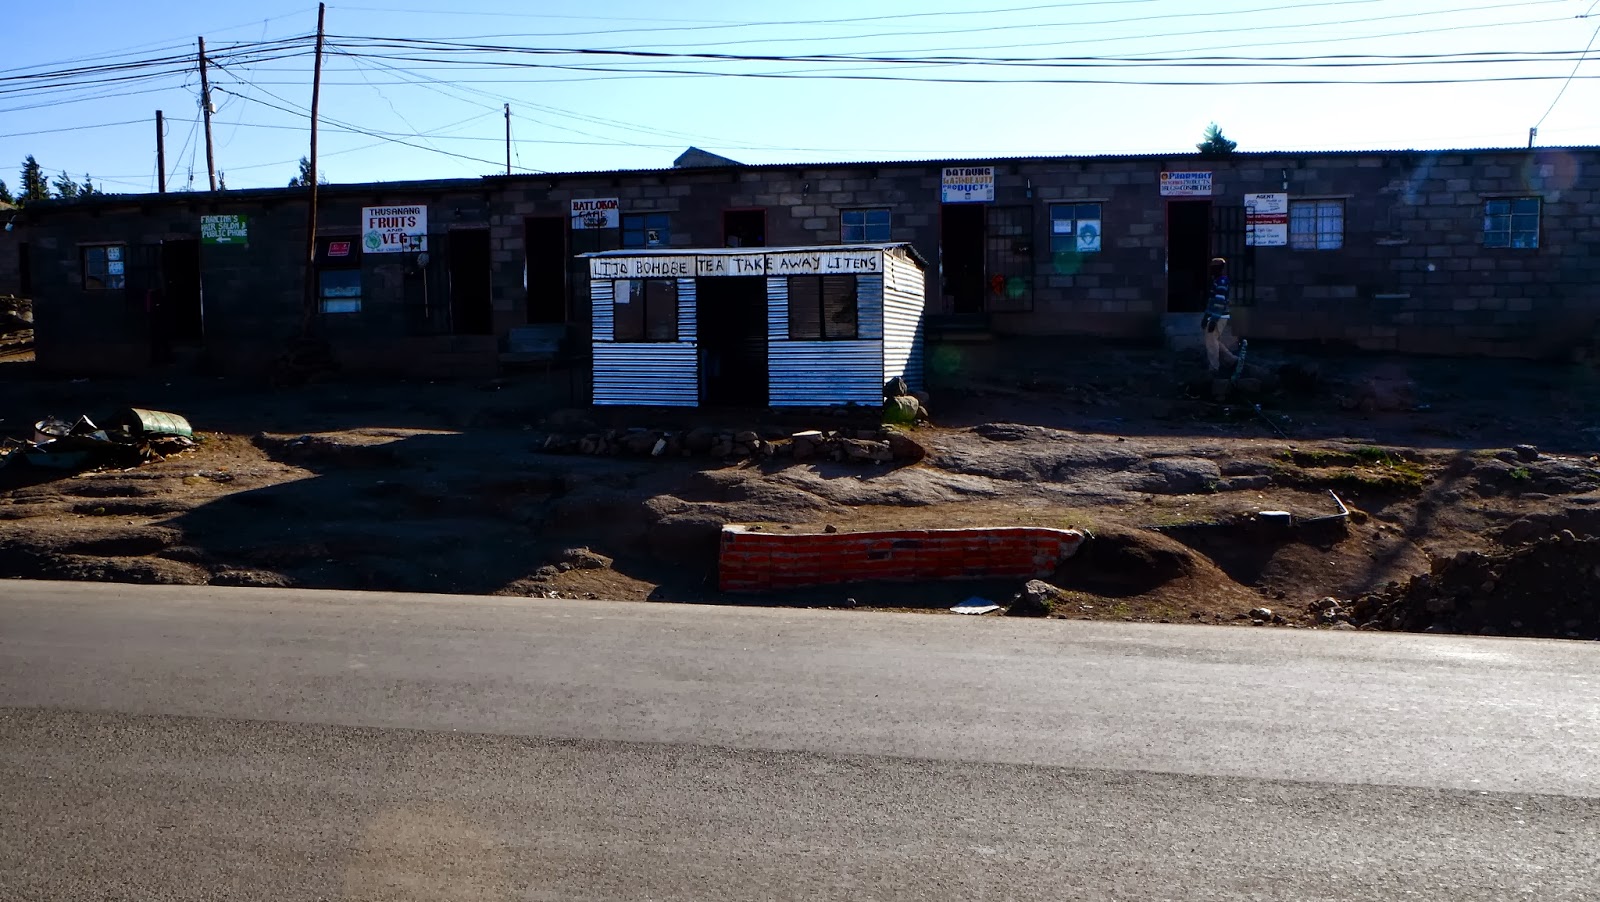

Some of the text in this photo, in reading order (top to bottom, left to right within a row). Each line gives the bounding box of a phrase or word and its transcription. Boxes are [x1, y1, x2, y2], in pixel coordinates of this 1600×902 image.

[946, 168, 991, 176] BATAUNG
[1169, 172, 1212, 180] PHARMACY
[573, 200, 619, 210] BATLOKOA
[370, 207, 420, 216] THUSANANG
[369, 216, 416, 228] FRUITS
[202, 229, 226, 238] PUBLIC
[382, 233, 408, 244] VEG
[699, 260, 724, 271] TEA
[733, 258, 773, 272] TAKE
[780, 257, 820, 270] AWAY
